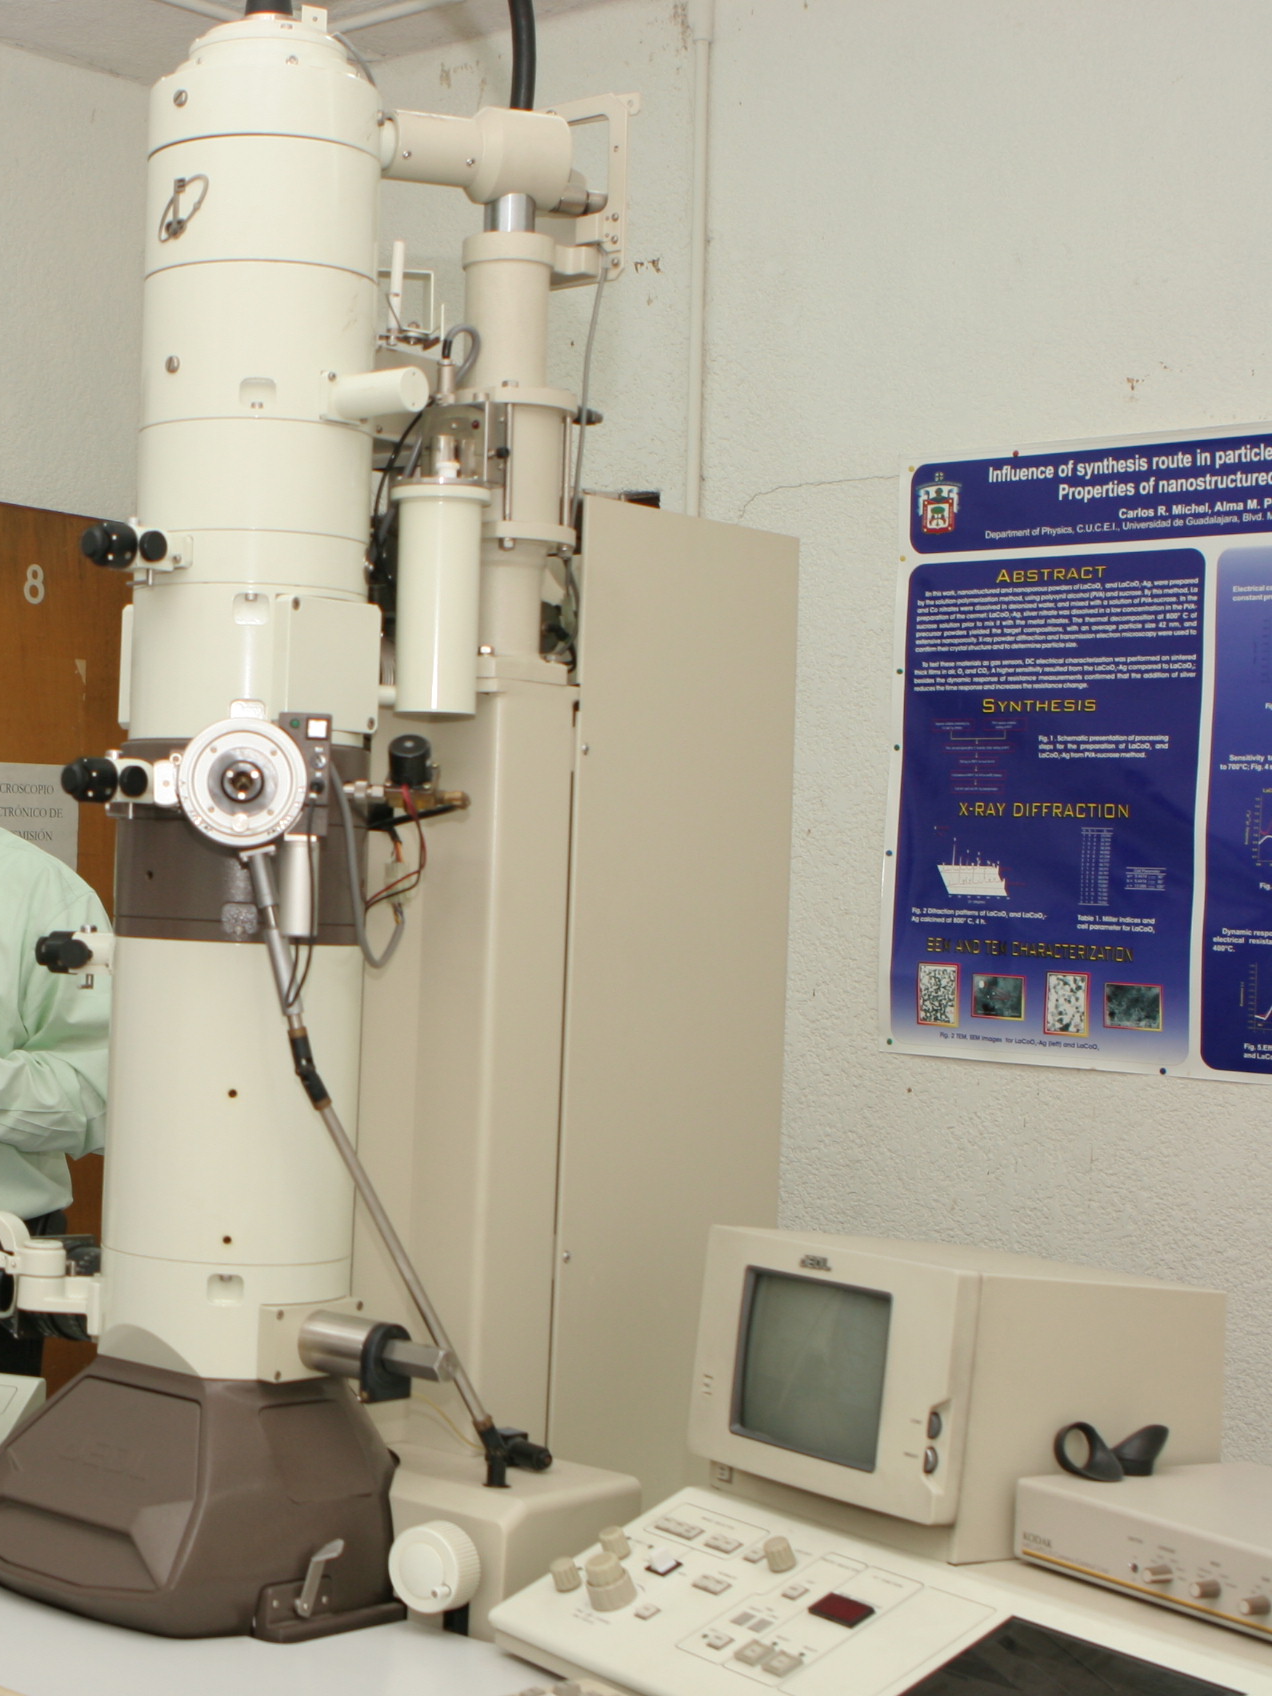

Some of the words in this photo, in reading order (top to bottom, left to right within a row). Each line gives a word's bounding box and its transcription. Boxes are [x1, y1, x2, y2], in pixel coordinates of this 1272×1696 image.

[988, 465, 1054, 482] Influence
[1058, 460, 1074, 477] of
[1076, 454, 1148, 480] synthesis
[1152, 452, 1192, 470] route
[1196, 449, 1210, 466] in
[1215, 443, 1272, 468] particle
[1058, 480, 1135, 502] Properties
[1140, 476, 1156, 494] of
[1118, 507, 1154, 518] Carlos
[1158, 506, 1168, 516] R.
[1172, 502, 1212, 515] Michel,
[1214, 500, 1244, 512] Alma
[1247, 499, 1260, 510] M.
[985, 528, 1030, 540] Department
[1032, 528, 1040, 536] of
[1041, 526, 1074, 536] Physics,
[1122, 518, 1170, 530] Universidad
[1173, 518, 1184, 526] de
[1186, 514, 1240, 526] Guadalajara,
[24, 564, 44, 604] 8
[996, 566, 1107, 583] ABSTRACT
[982, 698, 1096, 712] SYNTHESIS
[49, 808, 63, 818] DE
[959, 802, 1006, 816] X-RAY
[1012, 802, 1129, 818] DIFFRACTION
[13, 828, 53, 841] MISIÓN
[1012, 942, 1133, 962] CHARACTERIZATION
